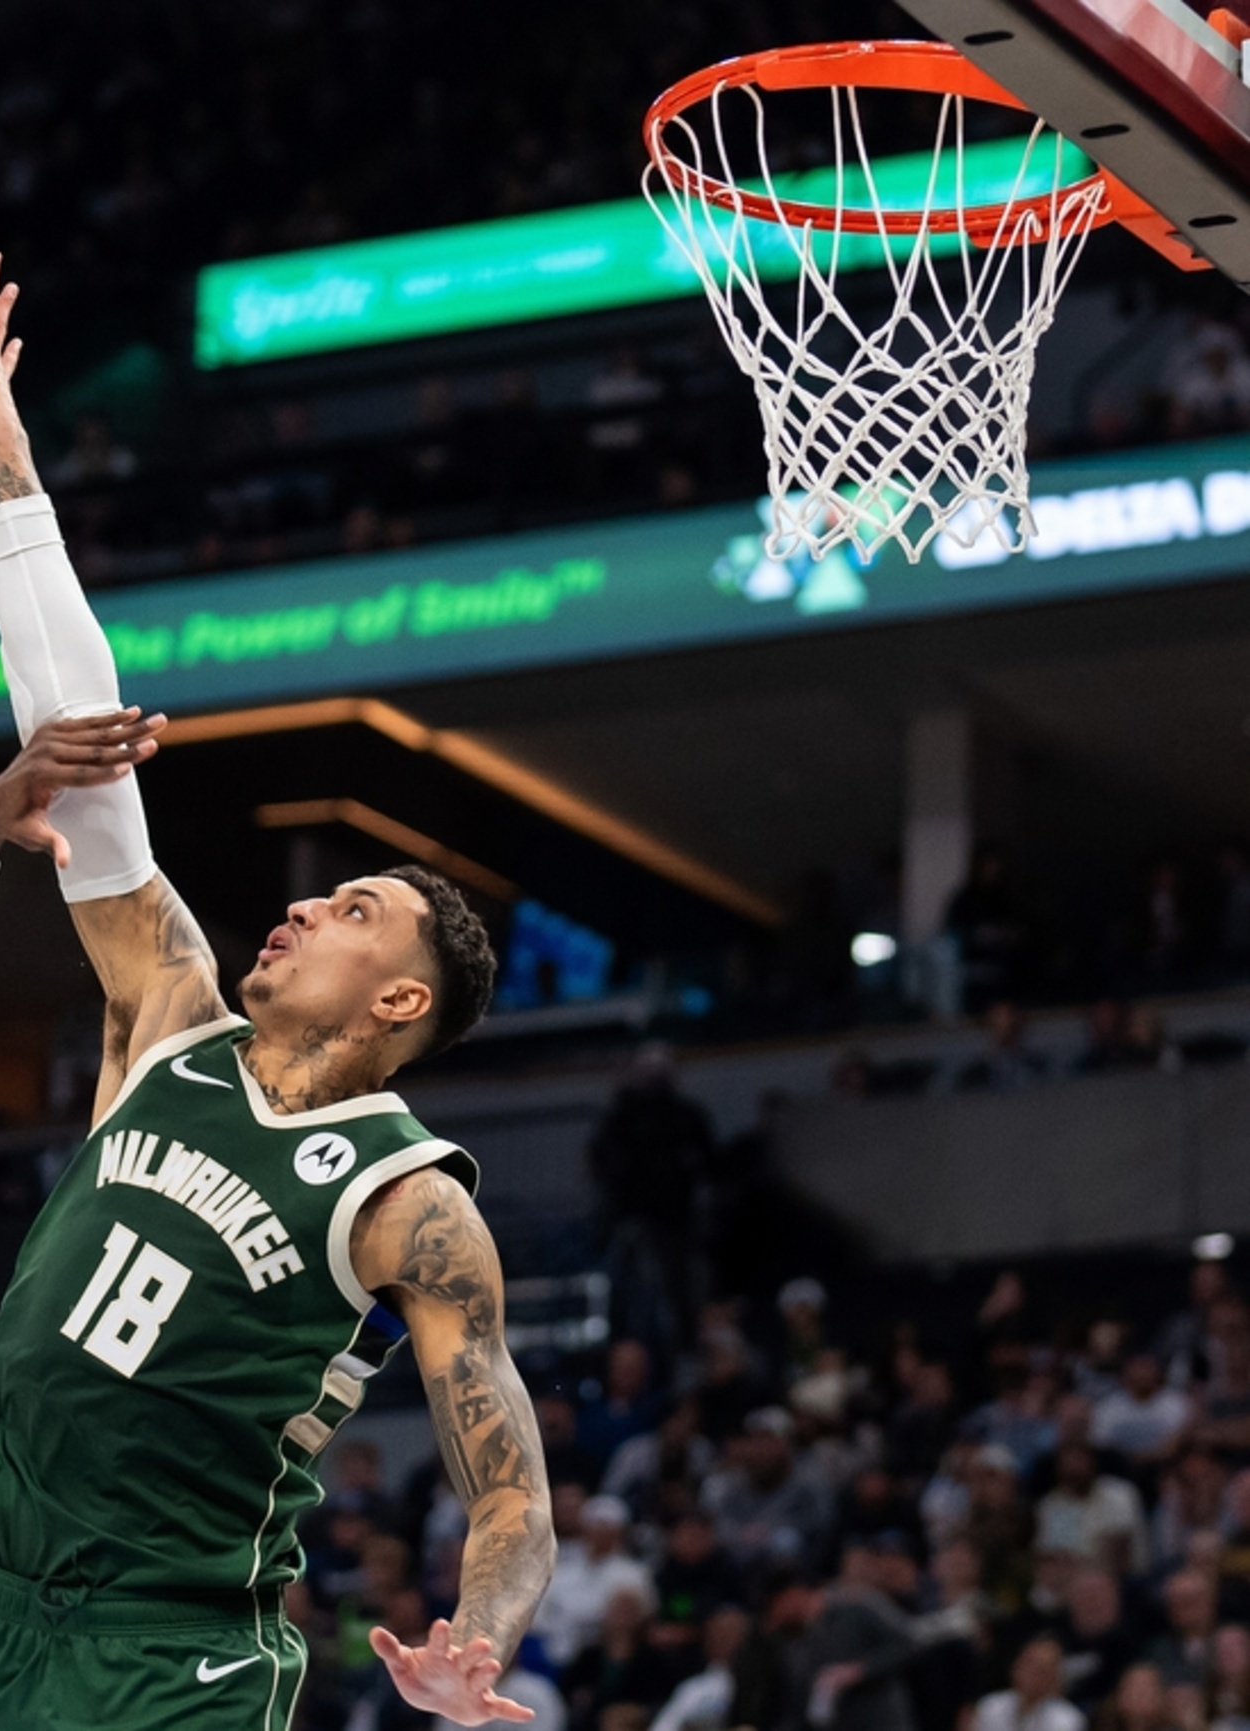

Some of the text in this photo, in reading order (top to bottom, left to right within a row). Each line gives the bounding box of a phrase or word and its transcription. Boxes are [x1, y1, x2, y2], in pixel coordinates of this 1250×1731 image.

[178, 604, 340, 668] Power
[341, 584, 409, 646] of
[96, 1129, 306, 1293] MILWAUKEE
[60, 1221, 193, 1380] 18
